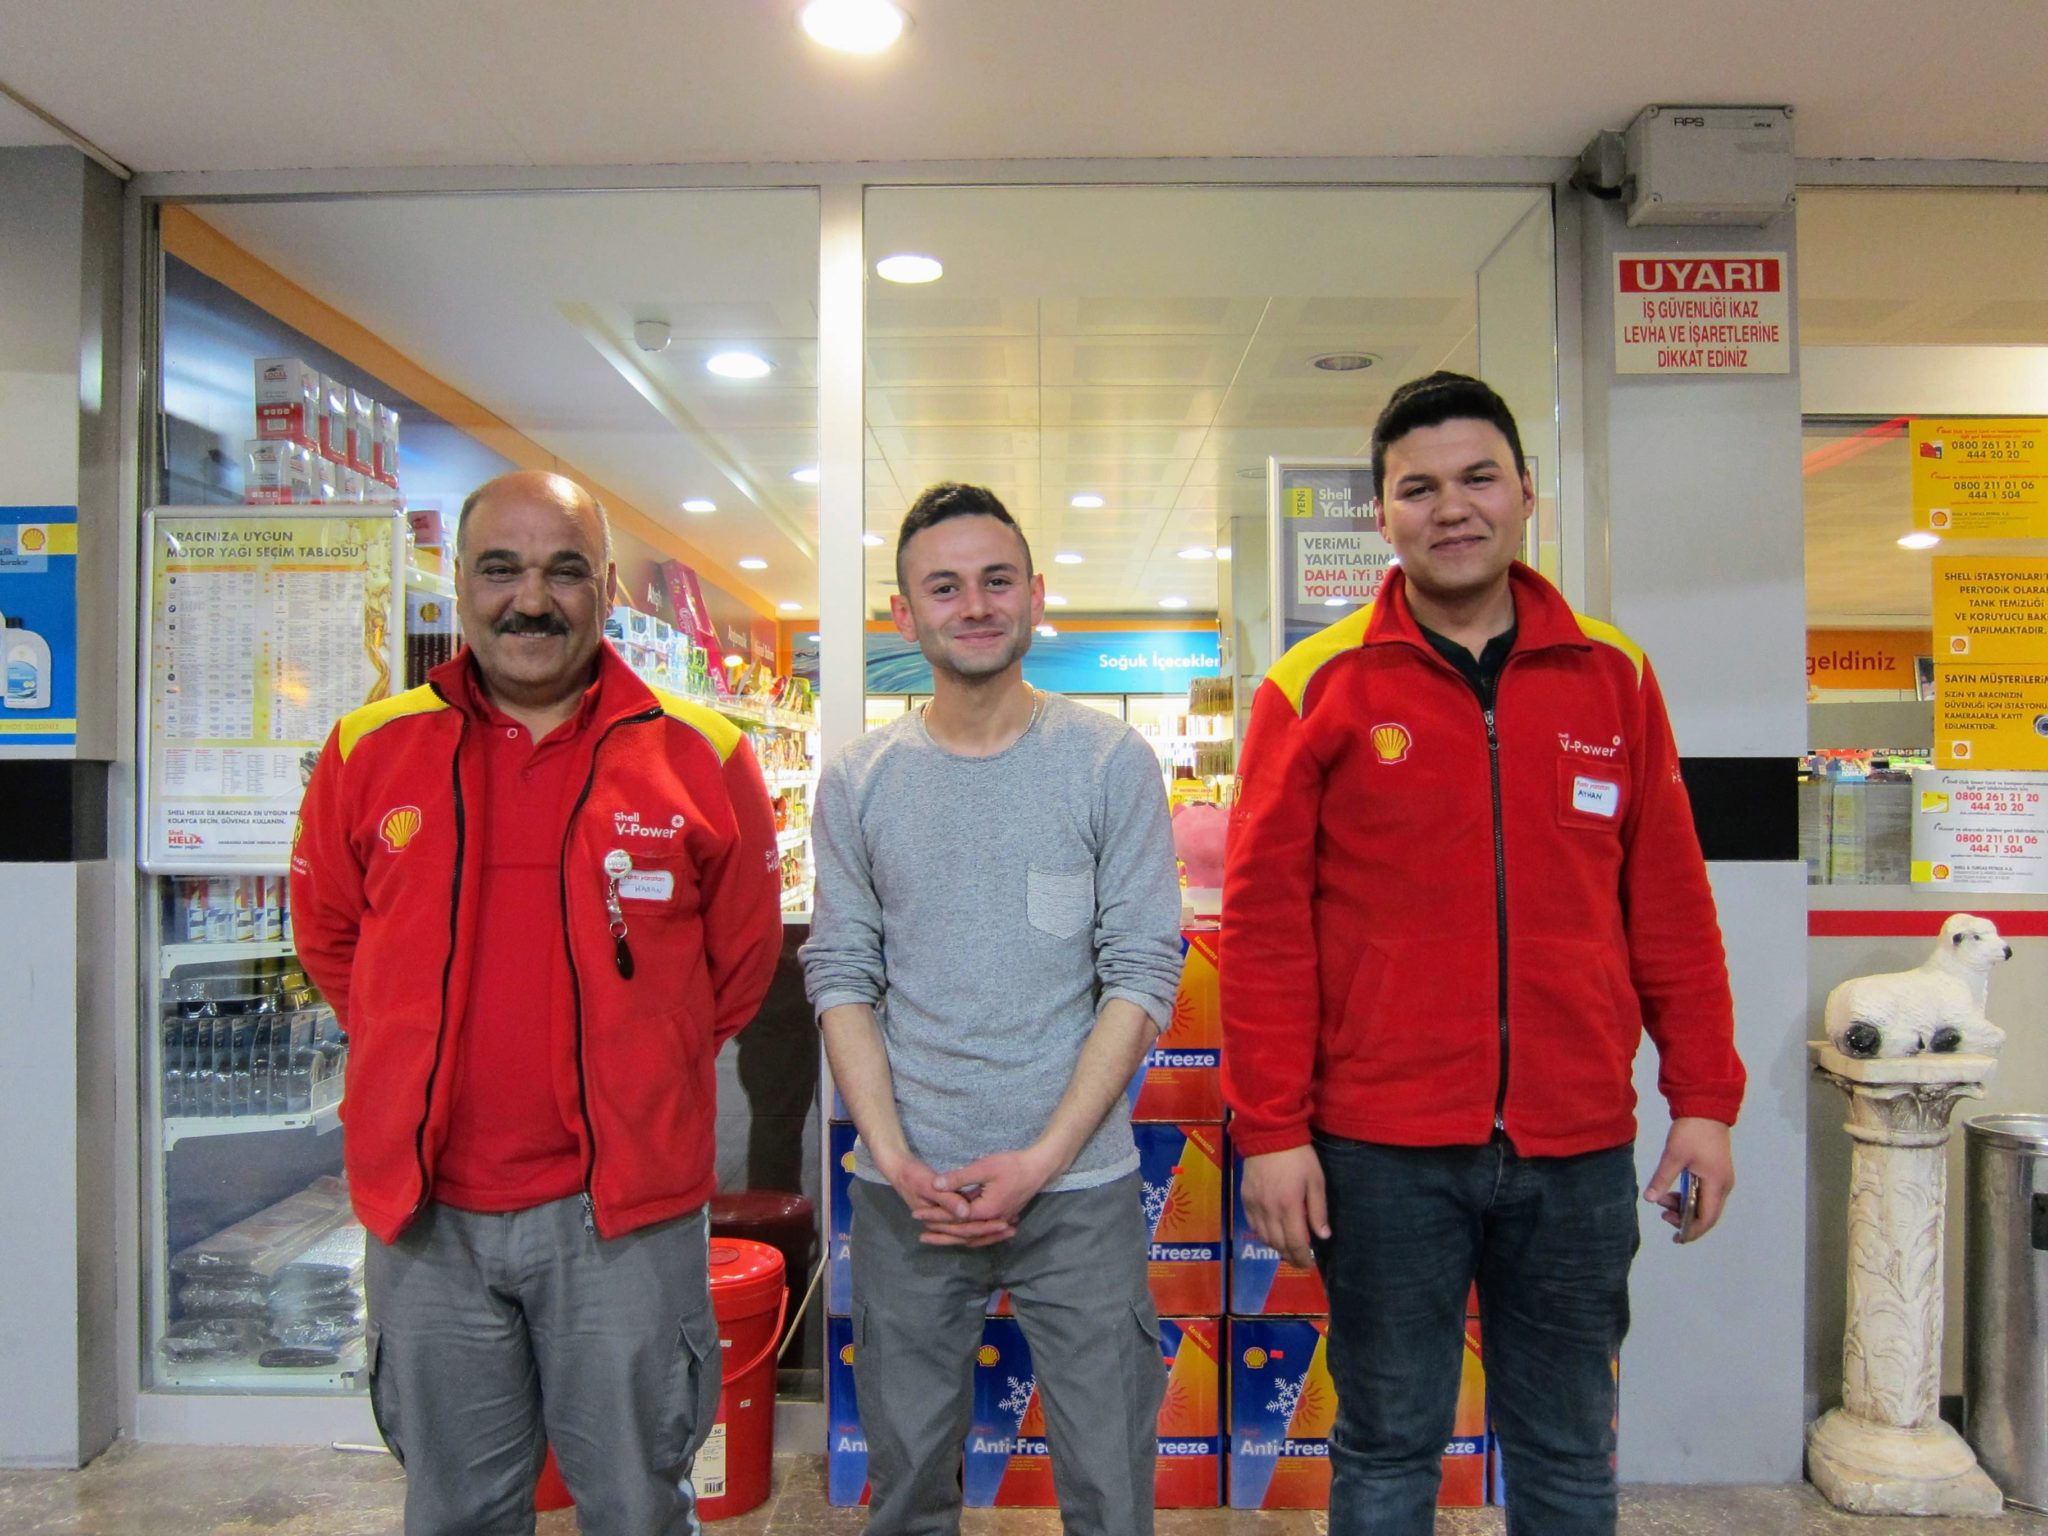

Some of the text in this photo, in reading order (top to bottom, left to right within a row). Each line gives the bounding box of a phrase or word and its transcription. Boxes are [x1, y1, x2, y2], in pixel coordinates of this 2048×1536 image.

[1635, 262, 1764, 290] UYARI
[1643, 297, 1759, 323] İŞ GÜVENLİĞİ İKAZ
[1624, 321, 1779, 347] LEVHA VE İŞARETLERİNE
[1658, 346, 1748, 368] DİKKAT EDİNİZ
[1951, 440, 2034, 449] 0800 261 21 20
[1967, 450, 2020, 459] 444 20 20
[1953, 481, 2034, 490] 0800 211 01 06
[1318, 487, 1351, 501] Shell
[1968, 491, 1988, 499] 444
[2001, 491, 2020, 499] 504
[243, 531, 293, 543] UYGUN
[166, 547, 215, 558] MOTOR
[299, 547, 359, 558] TABLOSU
[1304, 569, 1347, 582] DAHA
[1944, 572, 1971, 581] SHELL
[1969, 599, 1995, 608] TANK
[1954, 612, 2048, 621] VE KORUYUCU BAK
[1098, 653, 1148, 671] Soğuk
[1806, 650, 1896, 676] geldiniz
[1944, 674, 1976, 683] SAYIN
[1944, 712, 1999, 720] KAMERALARLA
[1559, 739, 1617, 758] V-Power
[1955, 791, 2039, 802] 0800 261 21 20
[1970, 802, 2024, 811] 444 20 20
[614, 812, 640, 822] Shell
[615, 822, 677, 839] V-Power
[167, 835, 205, 845] HELIX
[1955, 833, 2038, 844] 0800 211 01 06
[1969, 844, 1990, 852] 444
[2003, 845, 2023, 853] 504
[1156, 1439, 1209, 1454] reeze
